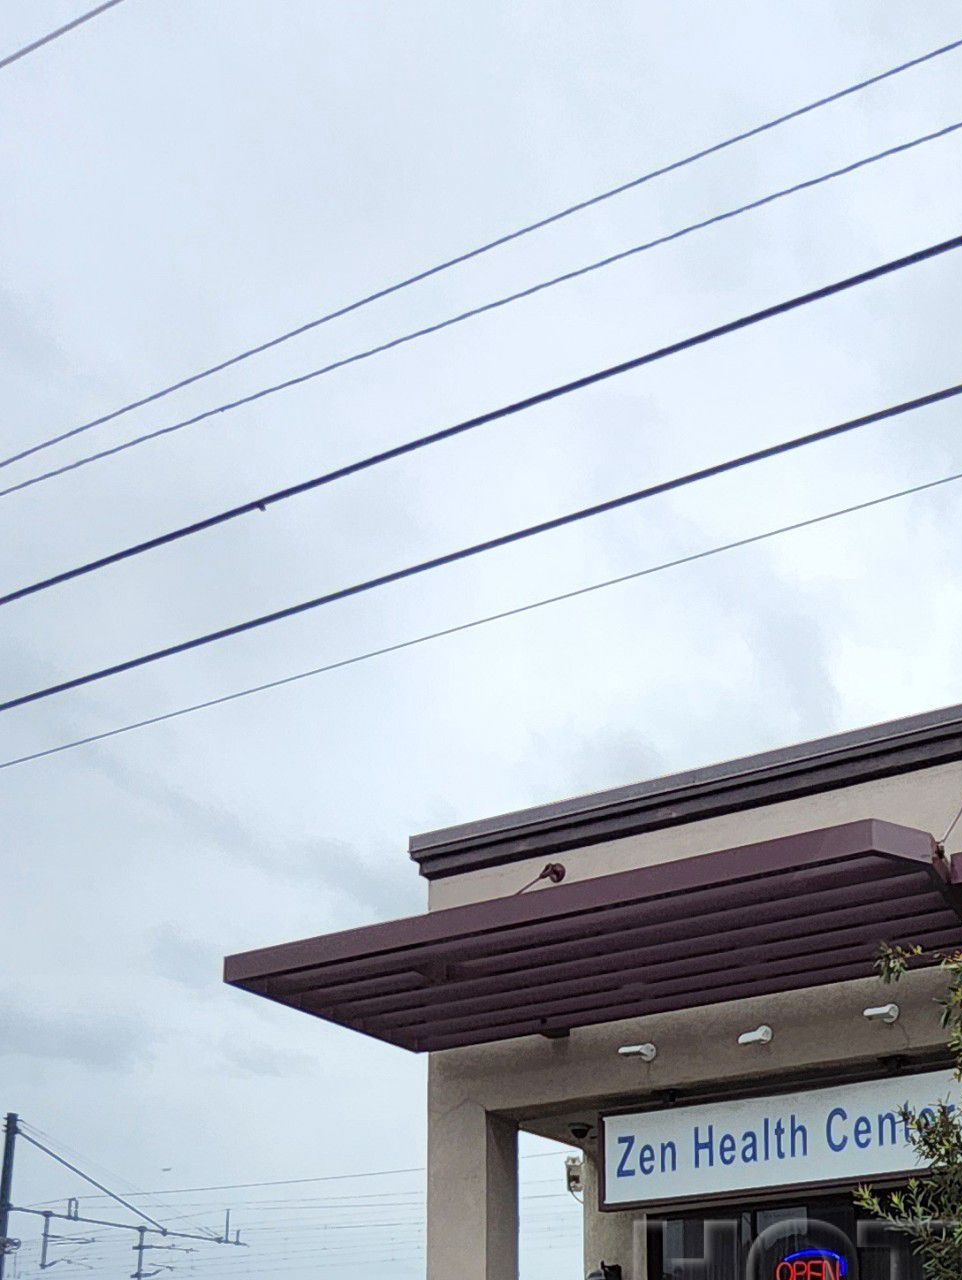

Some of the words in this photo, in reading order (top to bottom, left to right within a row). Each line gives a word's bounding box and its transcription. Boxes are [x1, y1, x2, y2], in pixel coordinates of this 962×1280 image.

[616, 1135, 677, 1178] Zen
[693, 1114, 808, 1169] Health
[825, 1102, 956, 1153] Cent
